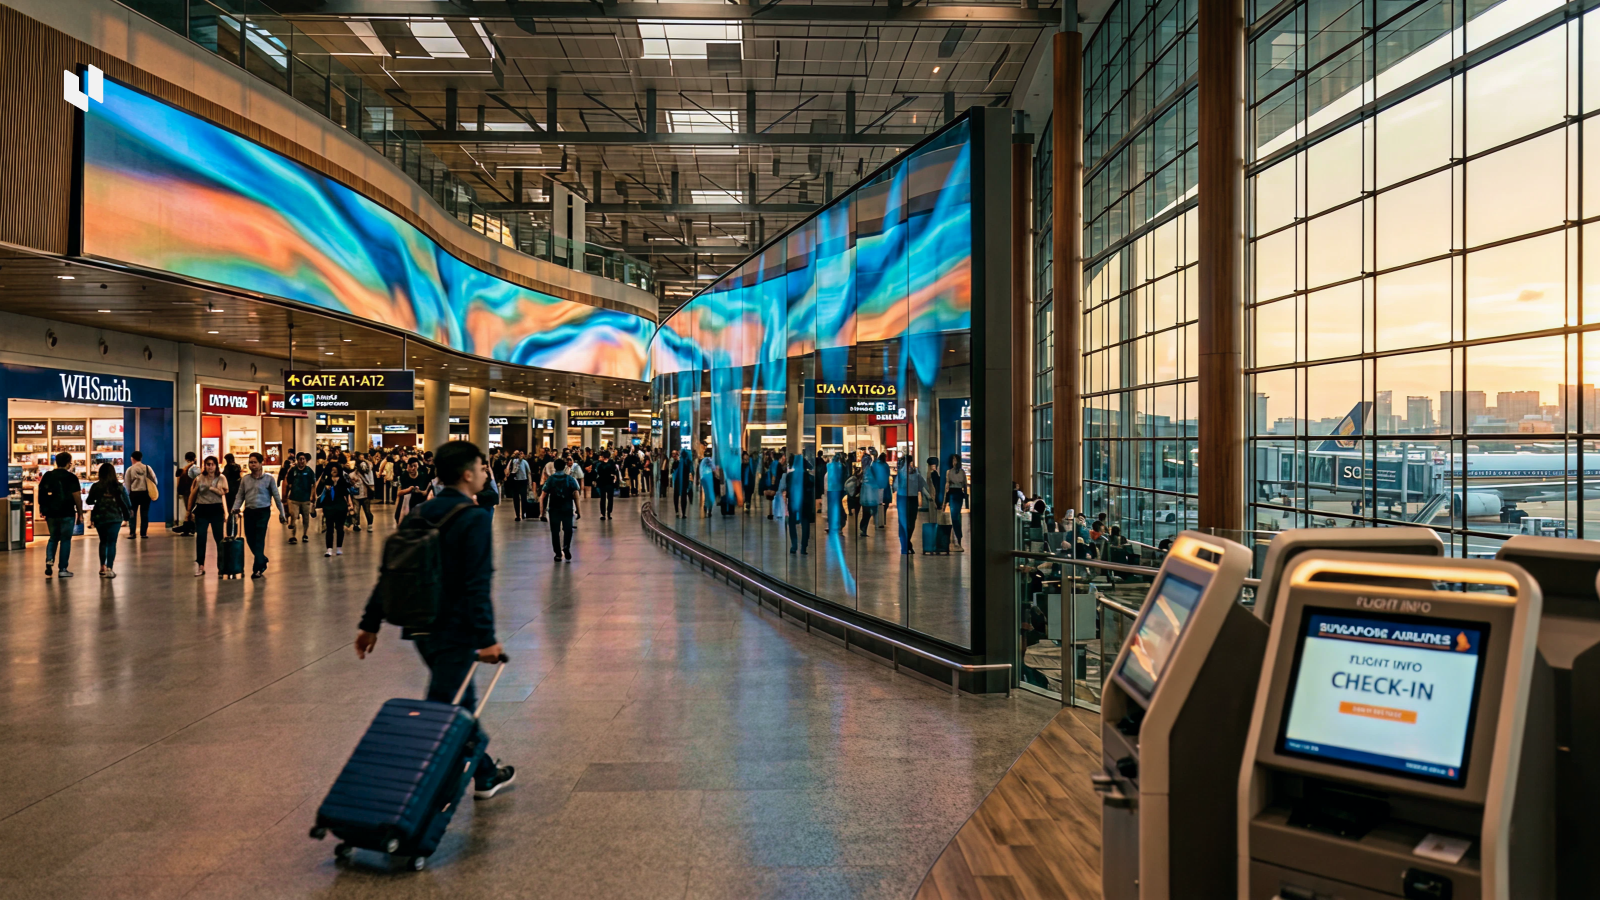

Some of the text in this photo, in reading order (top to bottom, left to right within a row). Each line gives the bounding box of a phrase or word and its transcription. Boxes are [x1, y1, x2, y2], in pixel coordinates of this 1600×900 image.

[59, 373, 132, 403] WHSmith
[302, 374, 385, 387] GATE A1-A12
[1331, 670, 1434, 701] CHECK-IN
